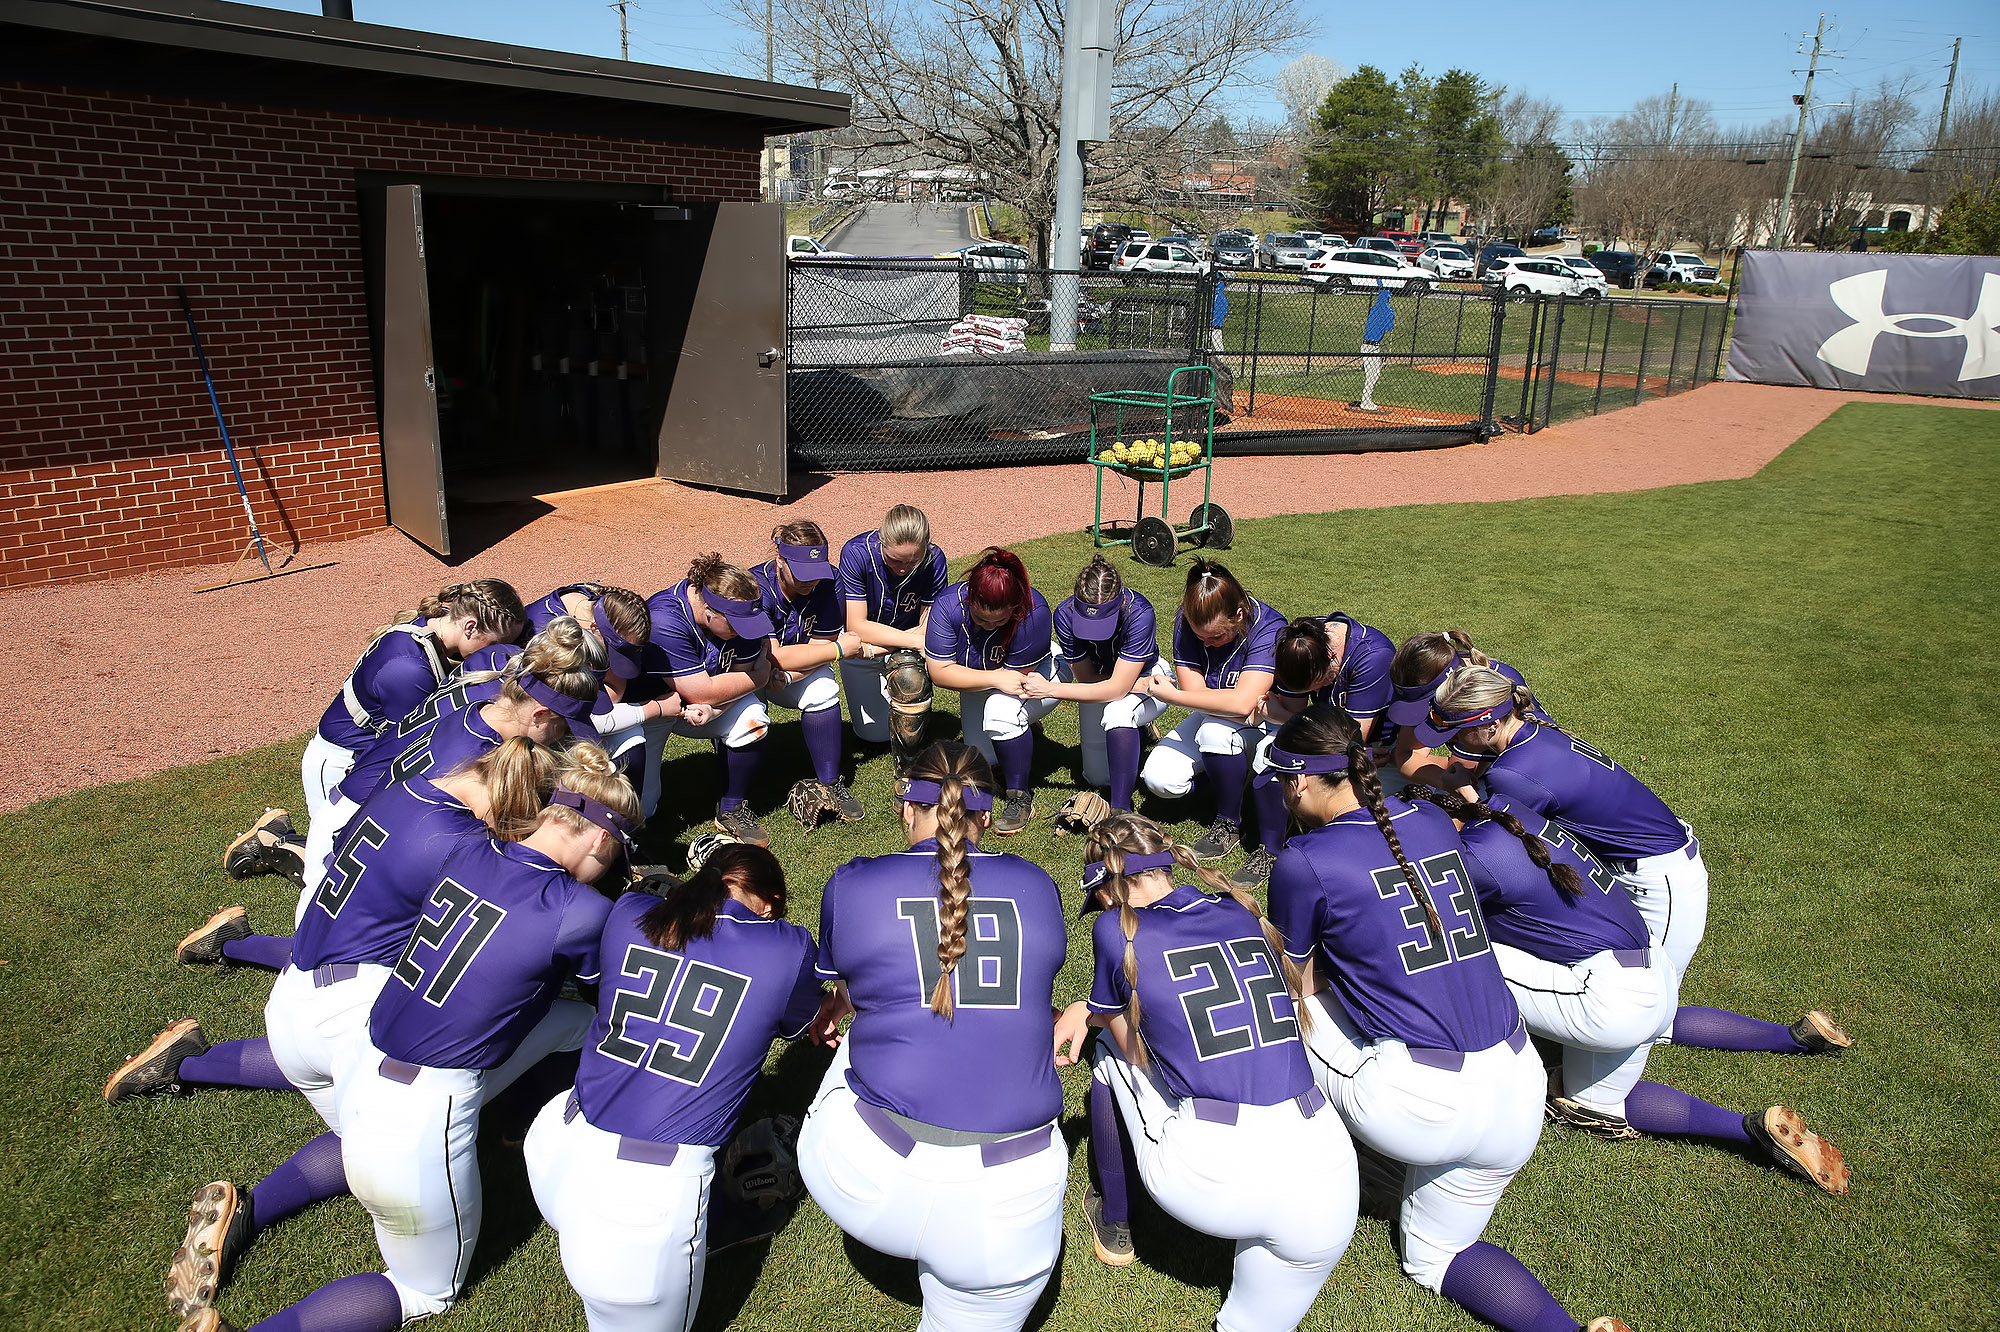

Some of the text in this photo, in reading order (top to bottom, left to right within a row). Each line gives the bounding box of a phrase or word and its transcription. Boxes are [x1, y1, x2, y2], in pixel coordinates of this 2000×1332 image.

[316, 816, 390, 920] 5
[1369, 849, 1491, 976] 33
[393, 876, 508, 1008] 21
[896, 896, 1023, 1010] 18
[1163, 936, 1299, 1062] 22
[596, 943, 753, 1088] 29
[744, 1177, 776, 1190] Wilson
